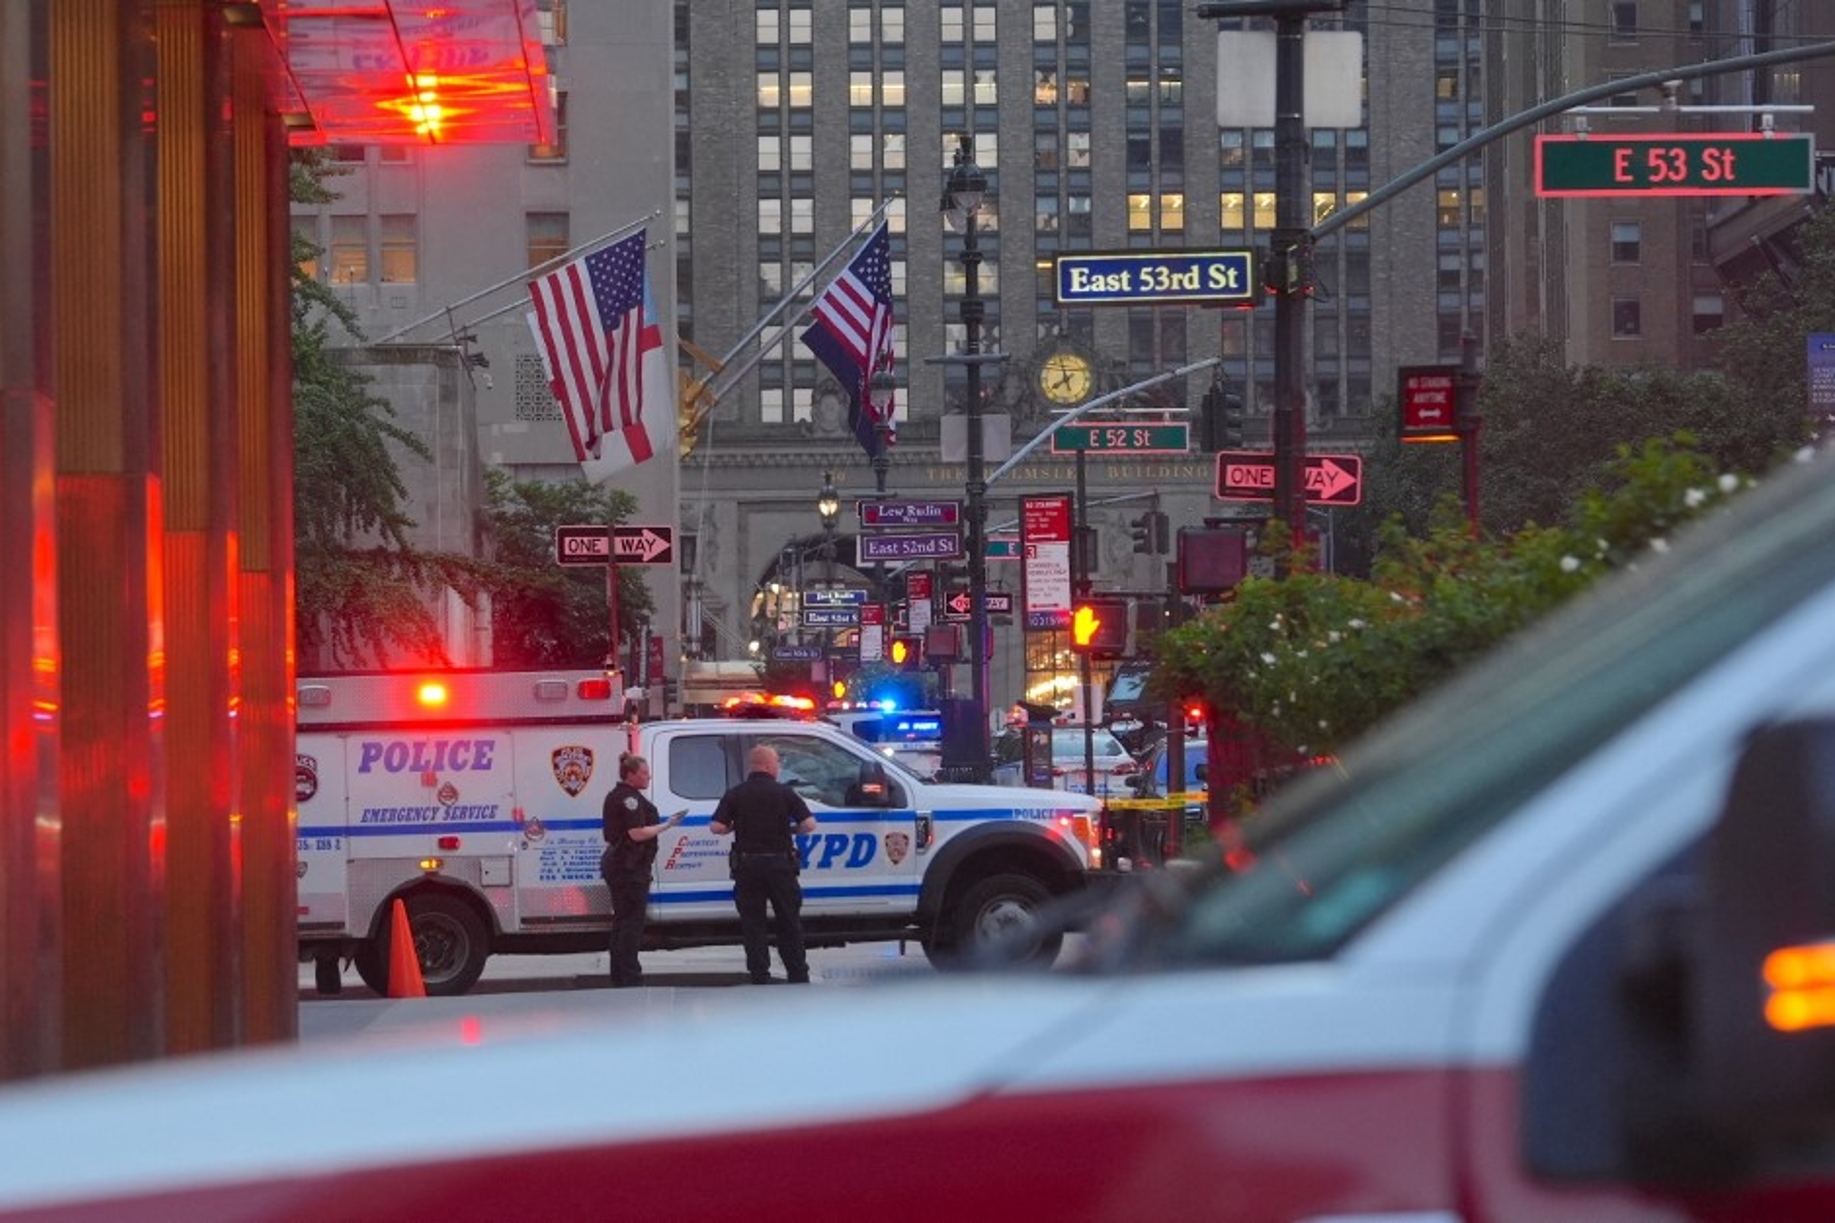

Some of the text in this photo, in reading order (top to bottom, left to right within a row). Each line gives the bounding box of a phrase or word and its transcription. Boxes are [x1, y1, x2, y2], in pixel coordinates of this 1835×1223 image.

[1615, 147, 1736, 182] E 53 St
[1070, 263, 1239, 292] East 53rd St
[1090, 429, 1150, 446] E 52 St
[1107, 466, 1209, 478] BUILDING
[1231, 468, 1271, 485] ONE
[879, 505, 941, 517] Lew Rudin
[569, 538, 656, 553] ONE WAY
[869, 538, 954, 555] East 52nd St
[1008, 543, 1016, 555] E
[1027, 546, 1035, 558] 3
[358, 740, 495, 774] POLICE
[360, 804, 499, 823] EMERGENCY SERVICE
[1012, 808, 1056, 820] POLICE
[795, 832, 877, 869] YPD
